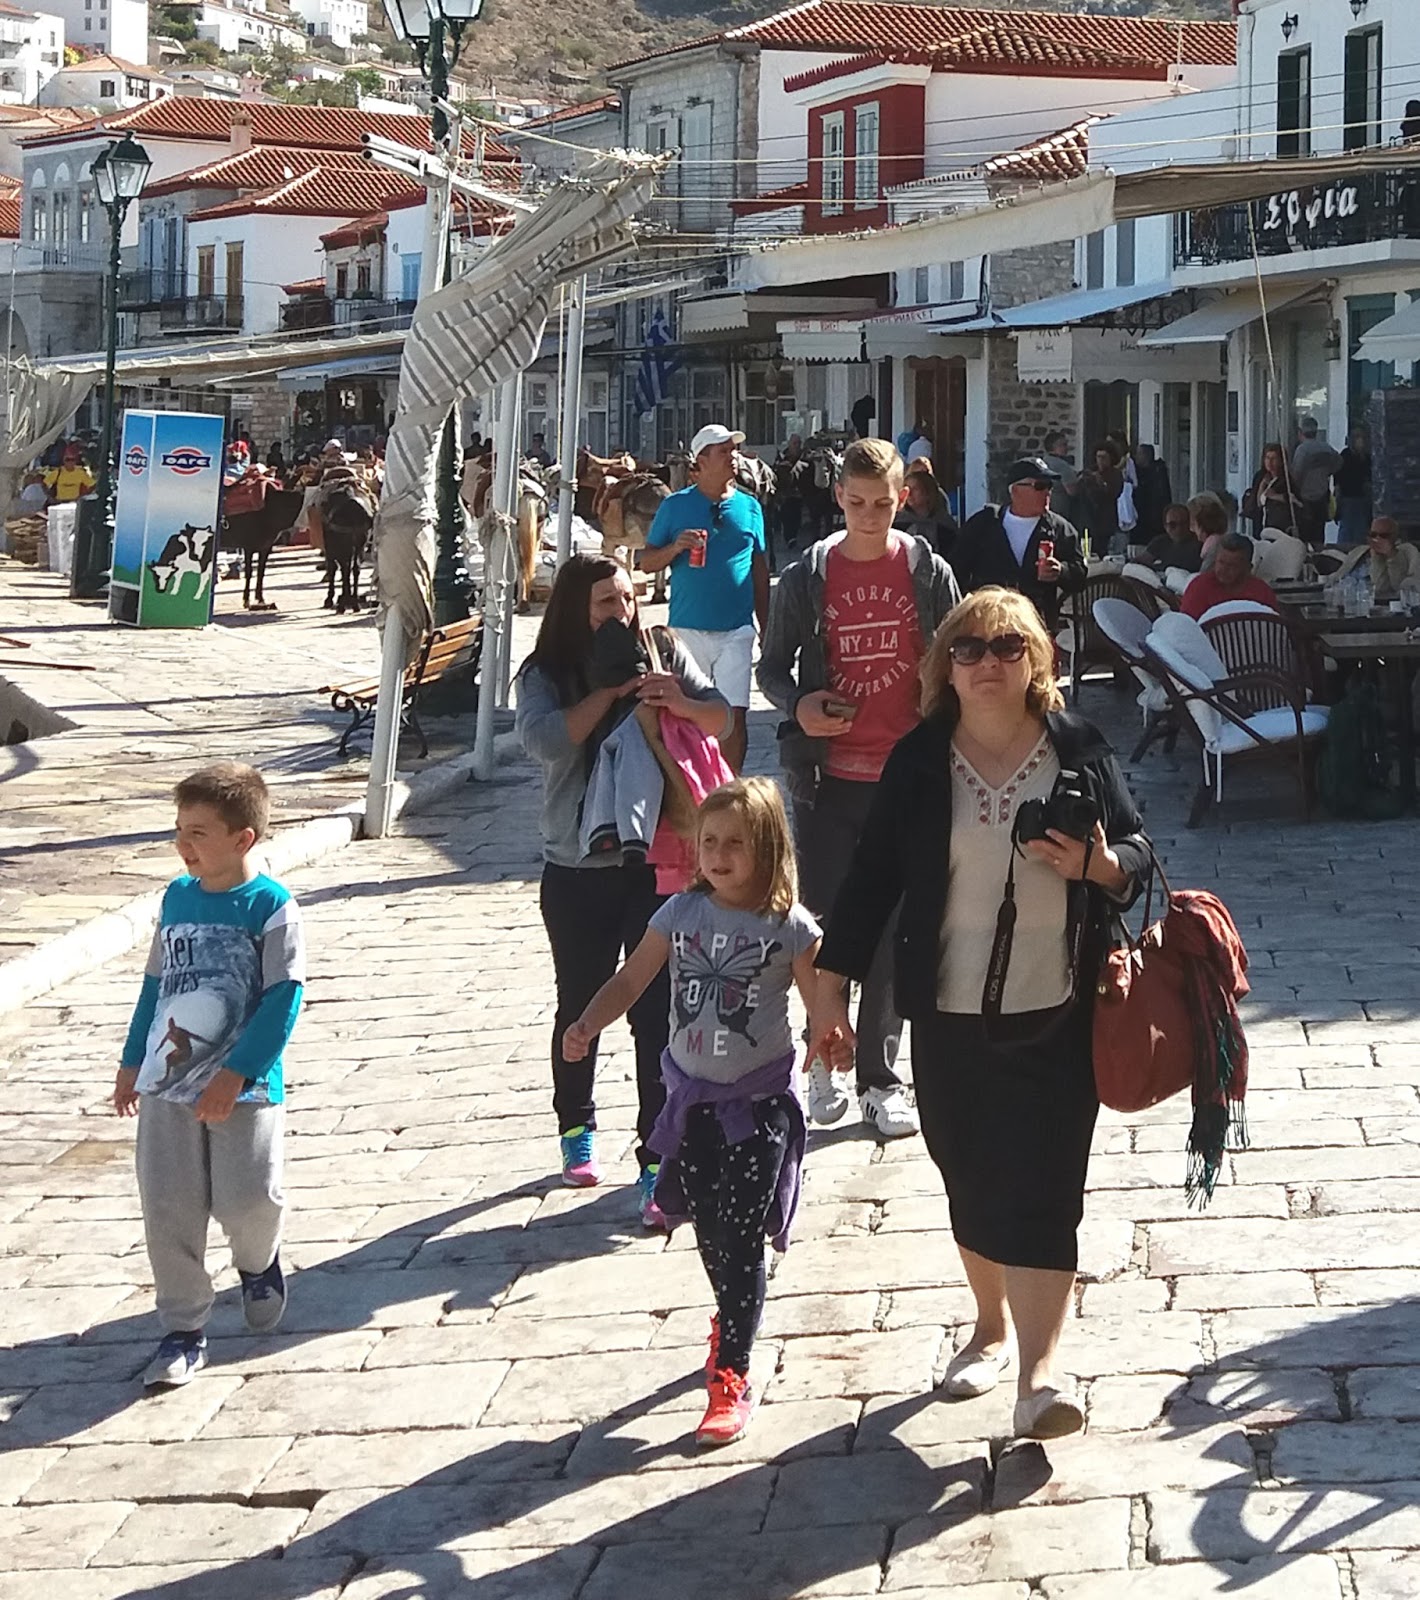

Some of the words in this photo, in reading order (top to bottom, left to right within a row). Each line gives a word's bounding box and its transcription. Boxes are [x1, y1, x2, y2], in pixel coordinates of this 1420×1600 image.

[841, 585, 893, 607] YORK
[840, 634, 861, 654] NY
[880, 631, 898, 650] LA
[671, 930, 776, 963] HAPPY
[686, 1029, 730, 1056] ME
